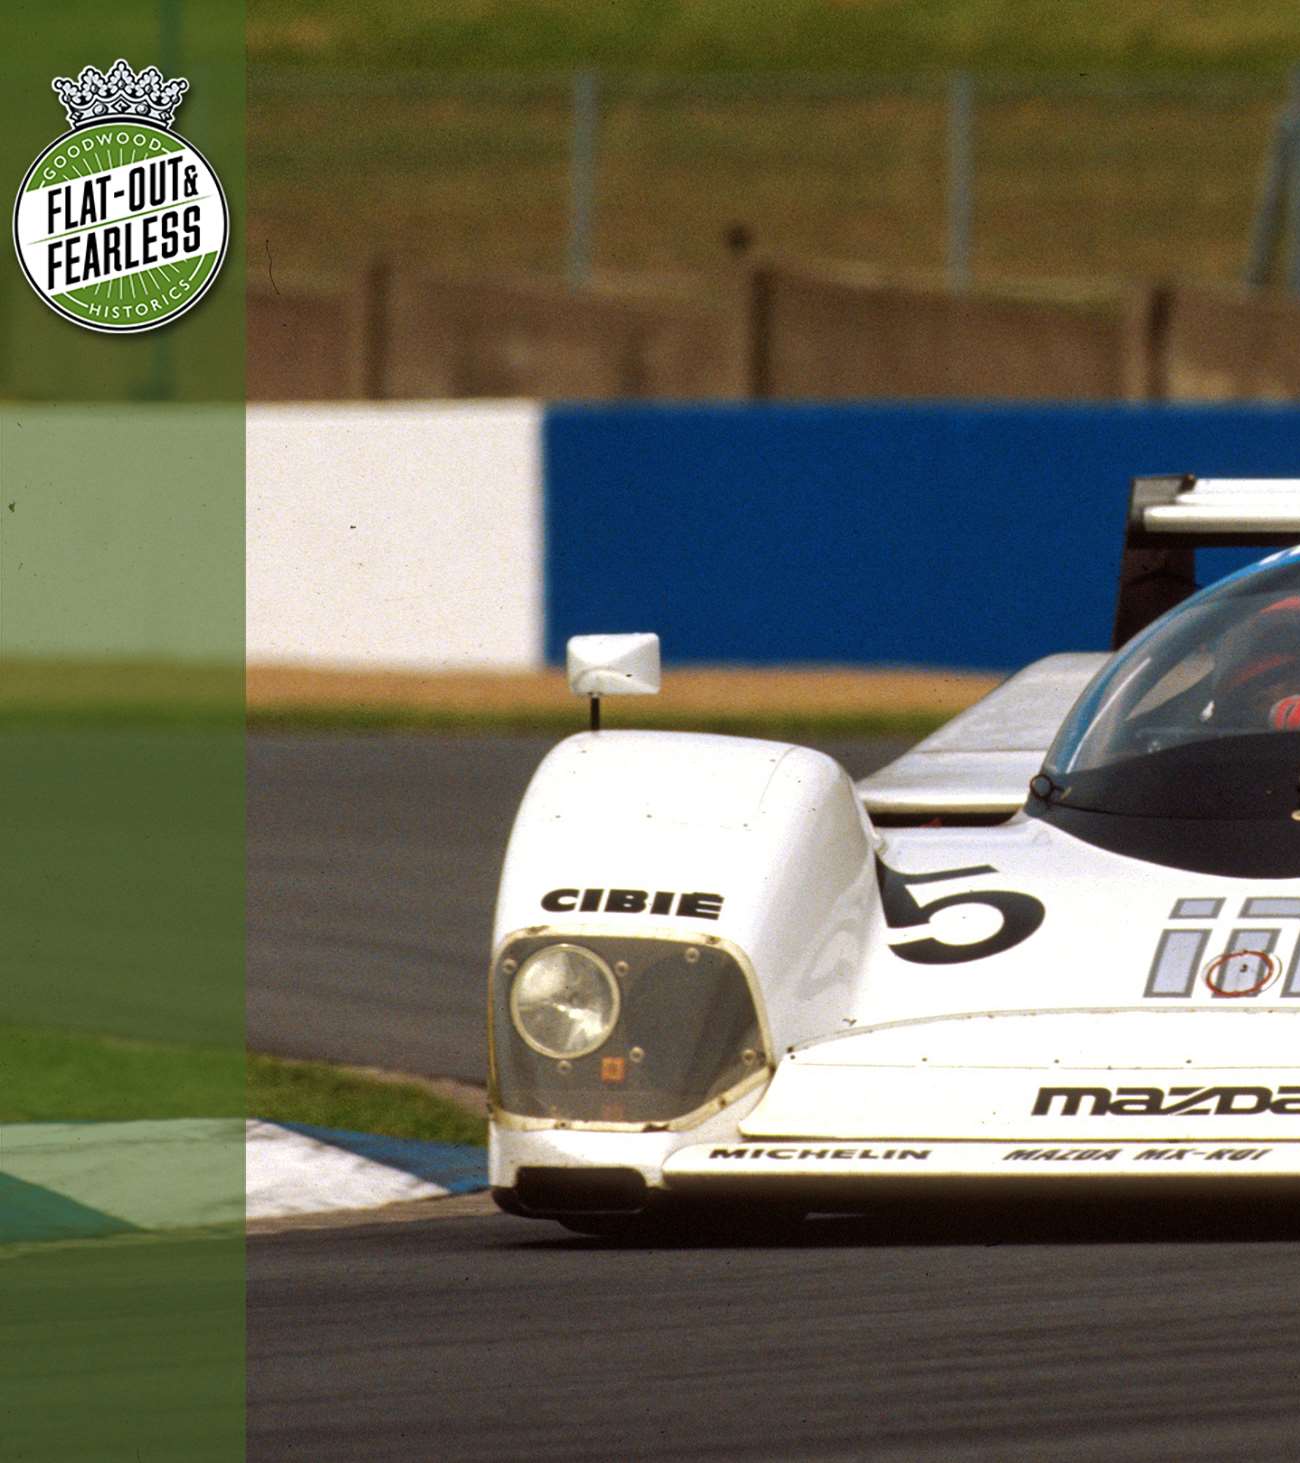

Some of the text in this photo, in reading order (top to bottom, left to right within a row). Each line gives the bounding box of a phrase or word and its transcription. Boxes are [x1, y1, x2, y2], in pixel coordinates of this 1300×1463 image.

[874, 850, 1046, 965] 5
[709, 1149, 932, 1160] MICHELIN
[1002, 1149, 1122, 1161] MAZDA
